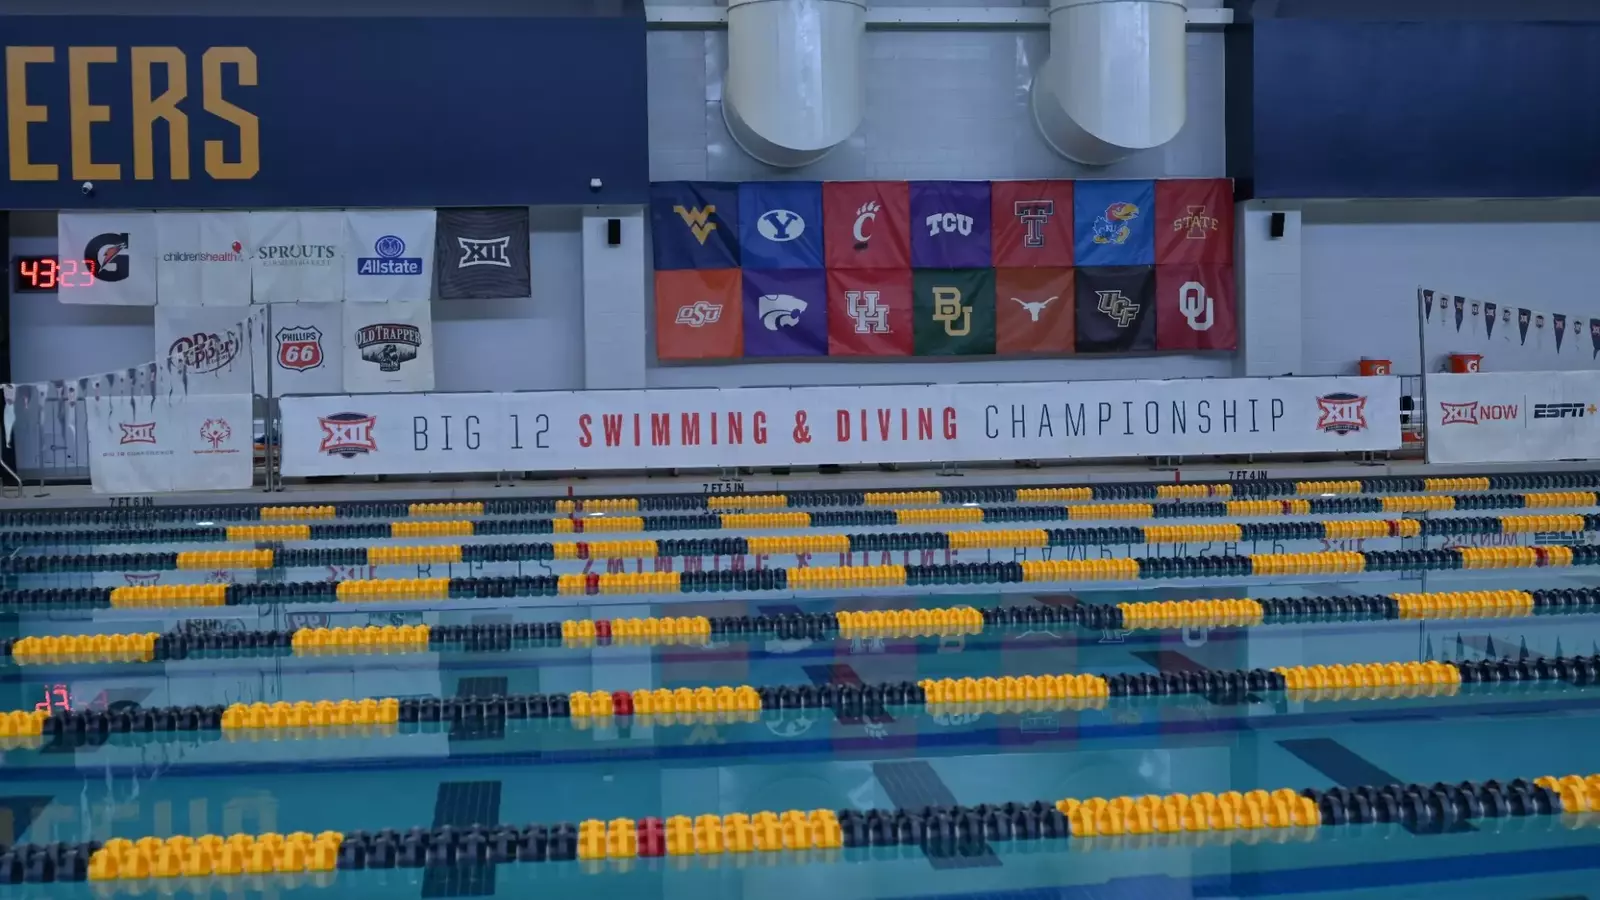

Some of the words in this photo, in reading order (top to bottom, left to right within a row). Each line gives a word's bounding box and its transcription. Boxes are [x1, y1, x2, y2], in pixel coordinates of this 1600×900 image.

[926, 212, 974, 237] TCU
[1173, 215, 1218, 232] STATE
[84, 233, 130, 282] G
[259, 244, 336, 260] SPROUTS
[21, 259, 96, 288] 43:23
[360, 259, 418, 274] Allstate
[1096, 290, 1140, 328] UCF
[1179, 281, 1214, 331] OU
[679, 302, 721, 328] OSU
[282, 332, 317, 342] PHILLIPS
[355, 330, 375, 345] OLD
[375, 325, 422, 344] TRAPPER
[286, 345, 314, 362] 66
[1480, 405, 1518, 421] NOW
[413, 415, 480, 451] BIG
[510, 414, 550, 449] 12
[579, 410, 768, 447] SWIMMING
[793, 410, 812, 444] &
[837, 406, 957, 442] DIVING
[985, 398, 1284, 439] CHAMPIONSHIP
[1229, 471, 1234, 480] 7
[1237, 470, 1247, 480] FT
[1250, 470, 1255, 480] 4
[1258, 470, 1267, 480] IN
[703, 483, 708, 493] 7
[712, 483, 723, 493] FT
[726, 482, 731, 492] 5
[734, 482, 744, 492] IN
[118, 496, 130, 508] FT
